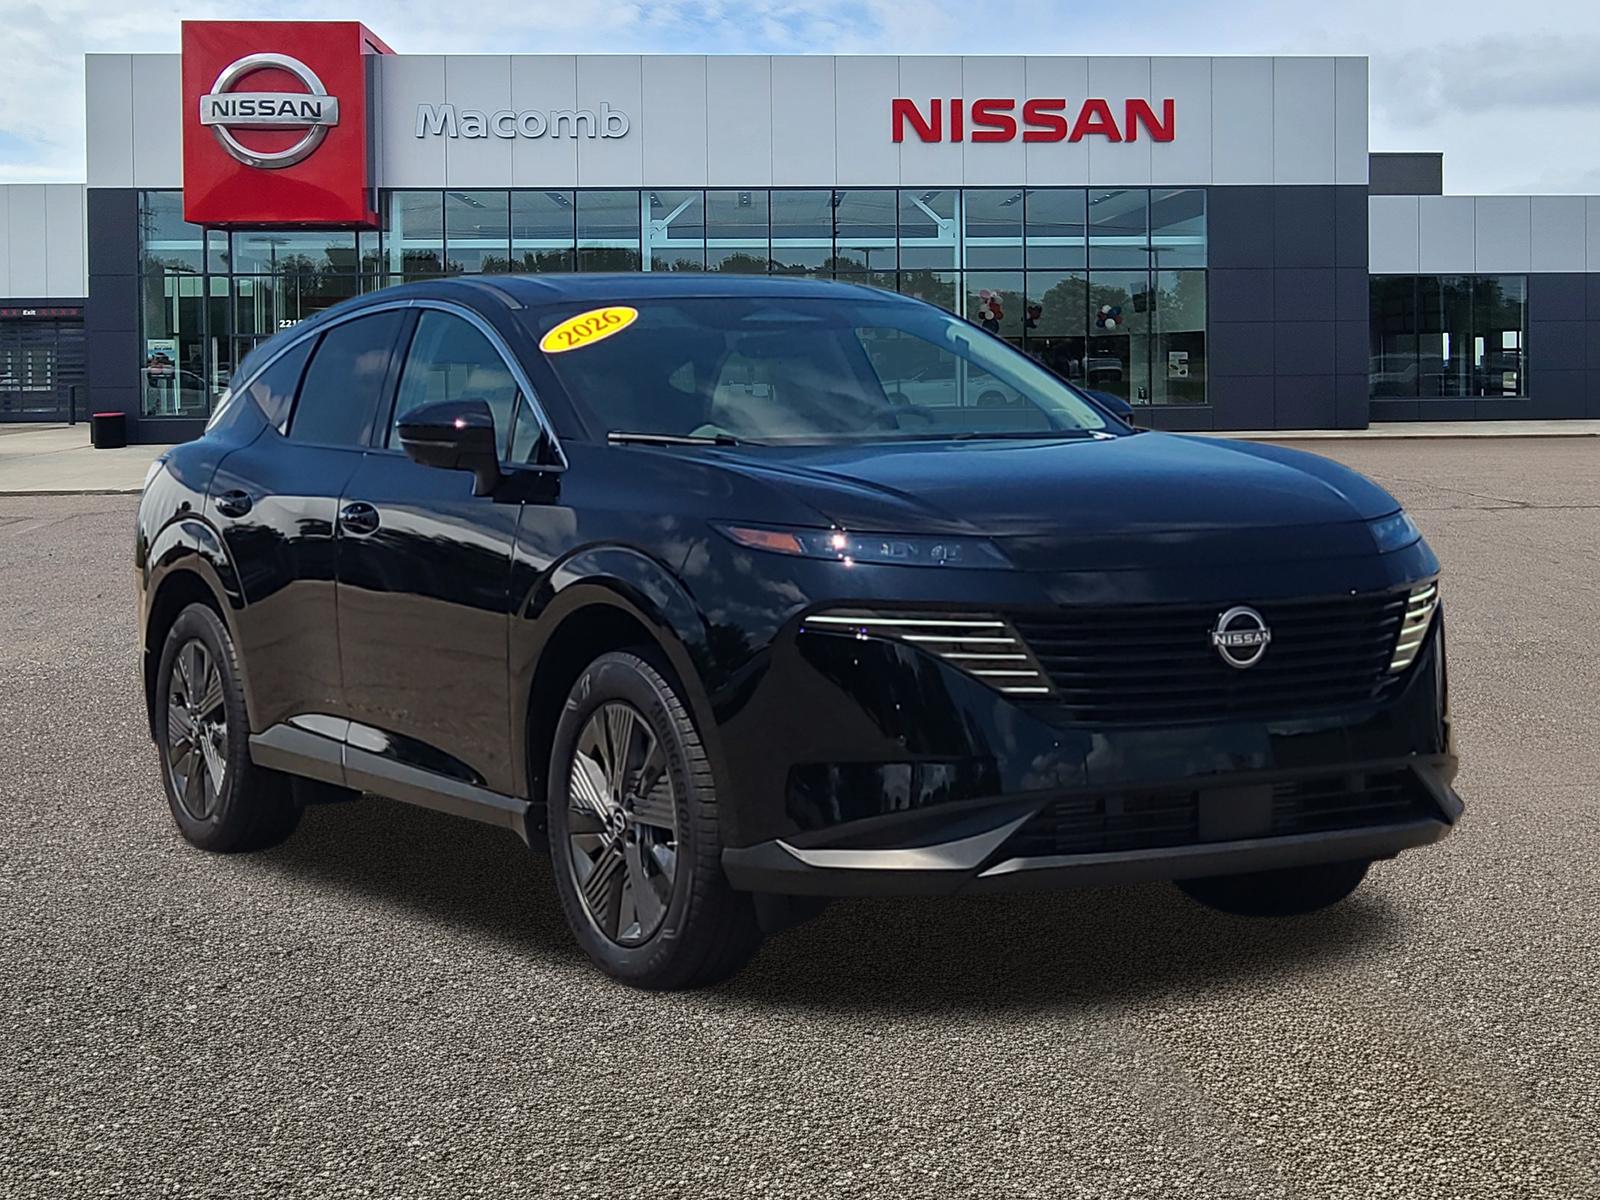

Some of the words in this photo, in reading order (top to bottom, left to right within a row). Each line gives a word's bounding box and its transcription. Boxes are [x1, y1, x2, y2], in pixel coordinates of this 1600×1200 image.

[212, 100, 322, 117] NISSAN
[415, 102, 629, 139] Macomb
[892, 98, 1175, 143] NISSAN
[557, 311, 622, 346] 2026
[1213, 631, 1271, 645] NISSAN
